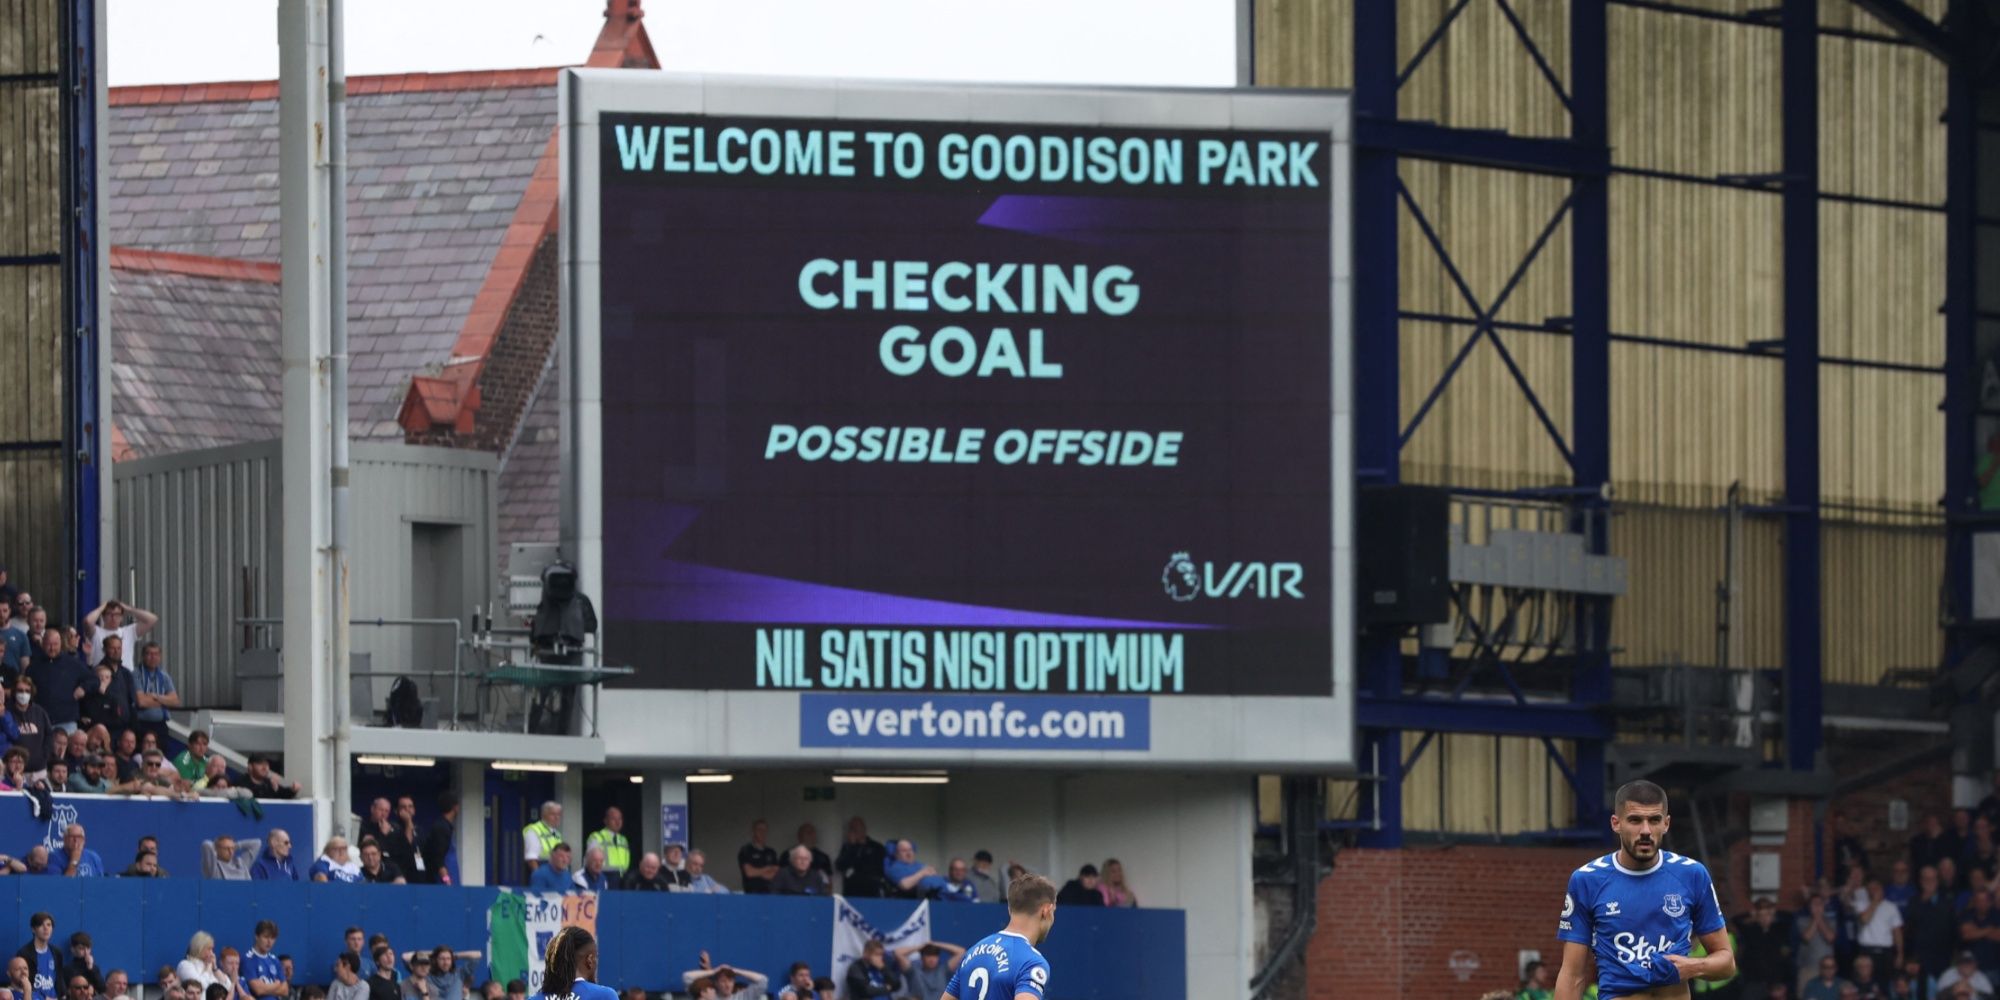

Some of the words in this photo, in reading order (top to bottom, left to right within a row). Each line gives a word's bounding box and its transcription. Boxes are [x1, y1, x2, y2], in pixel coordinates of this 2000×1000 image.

[615, 125, 855, 178] WELCOME
[866, 132, 924, 180] TO
[939, 133, 1183, 186] GOODISON
[1198, 139, 1319, 188] PARK
[798, 258, 1140, 316] CHECKING
[879, 325, 1063, 379] GOAL
[764, 424, 986, 463] POSSIBLE
[993, 429, 1184, 467] OFFSIDE
[1204, 561, 1304, 599] VAR
[756, 628, 813, 688] NIL
[820, 629, 926, 689] SATIS
[933, 631, 1006, 690] NISI
[1013, 632, 1184, 692] OPTIMUM
[827, 701, 1125, 739] evertonfc.com
[576, 900, 594, 920] FC
[1613, 931, 1675, 964] Stak
[968, 967, 989, 1000] 2
